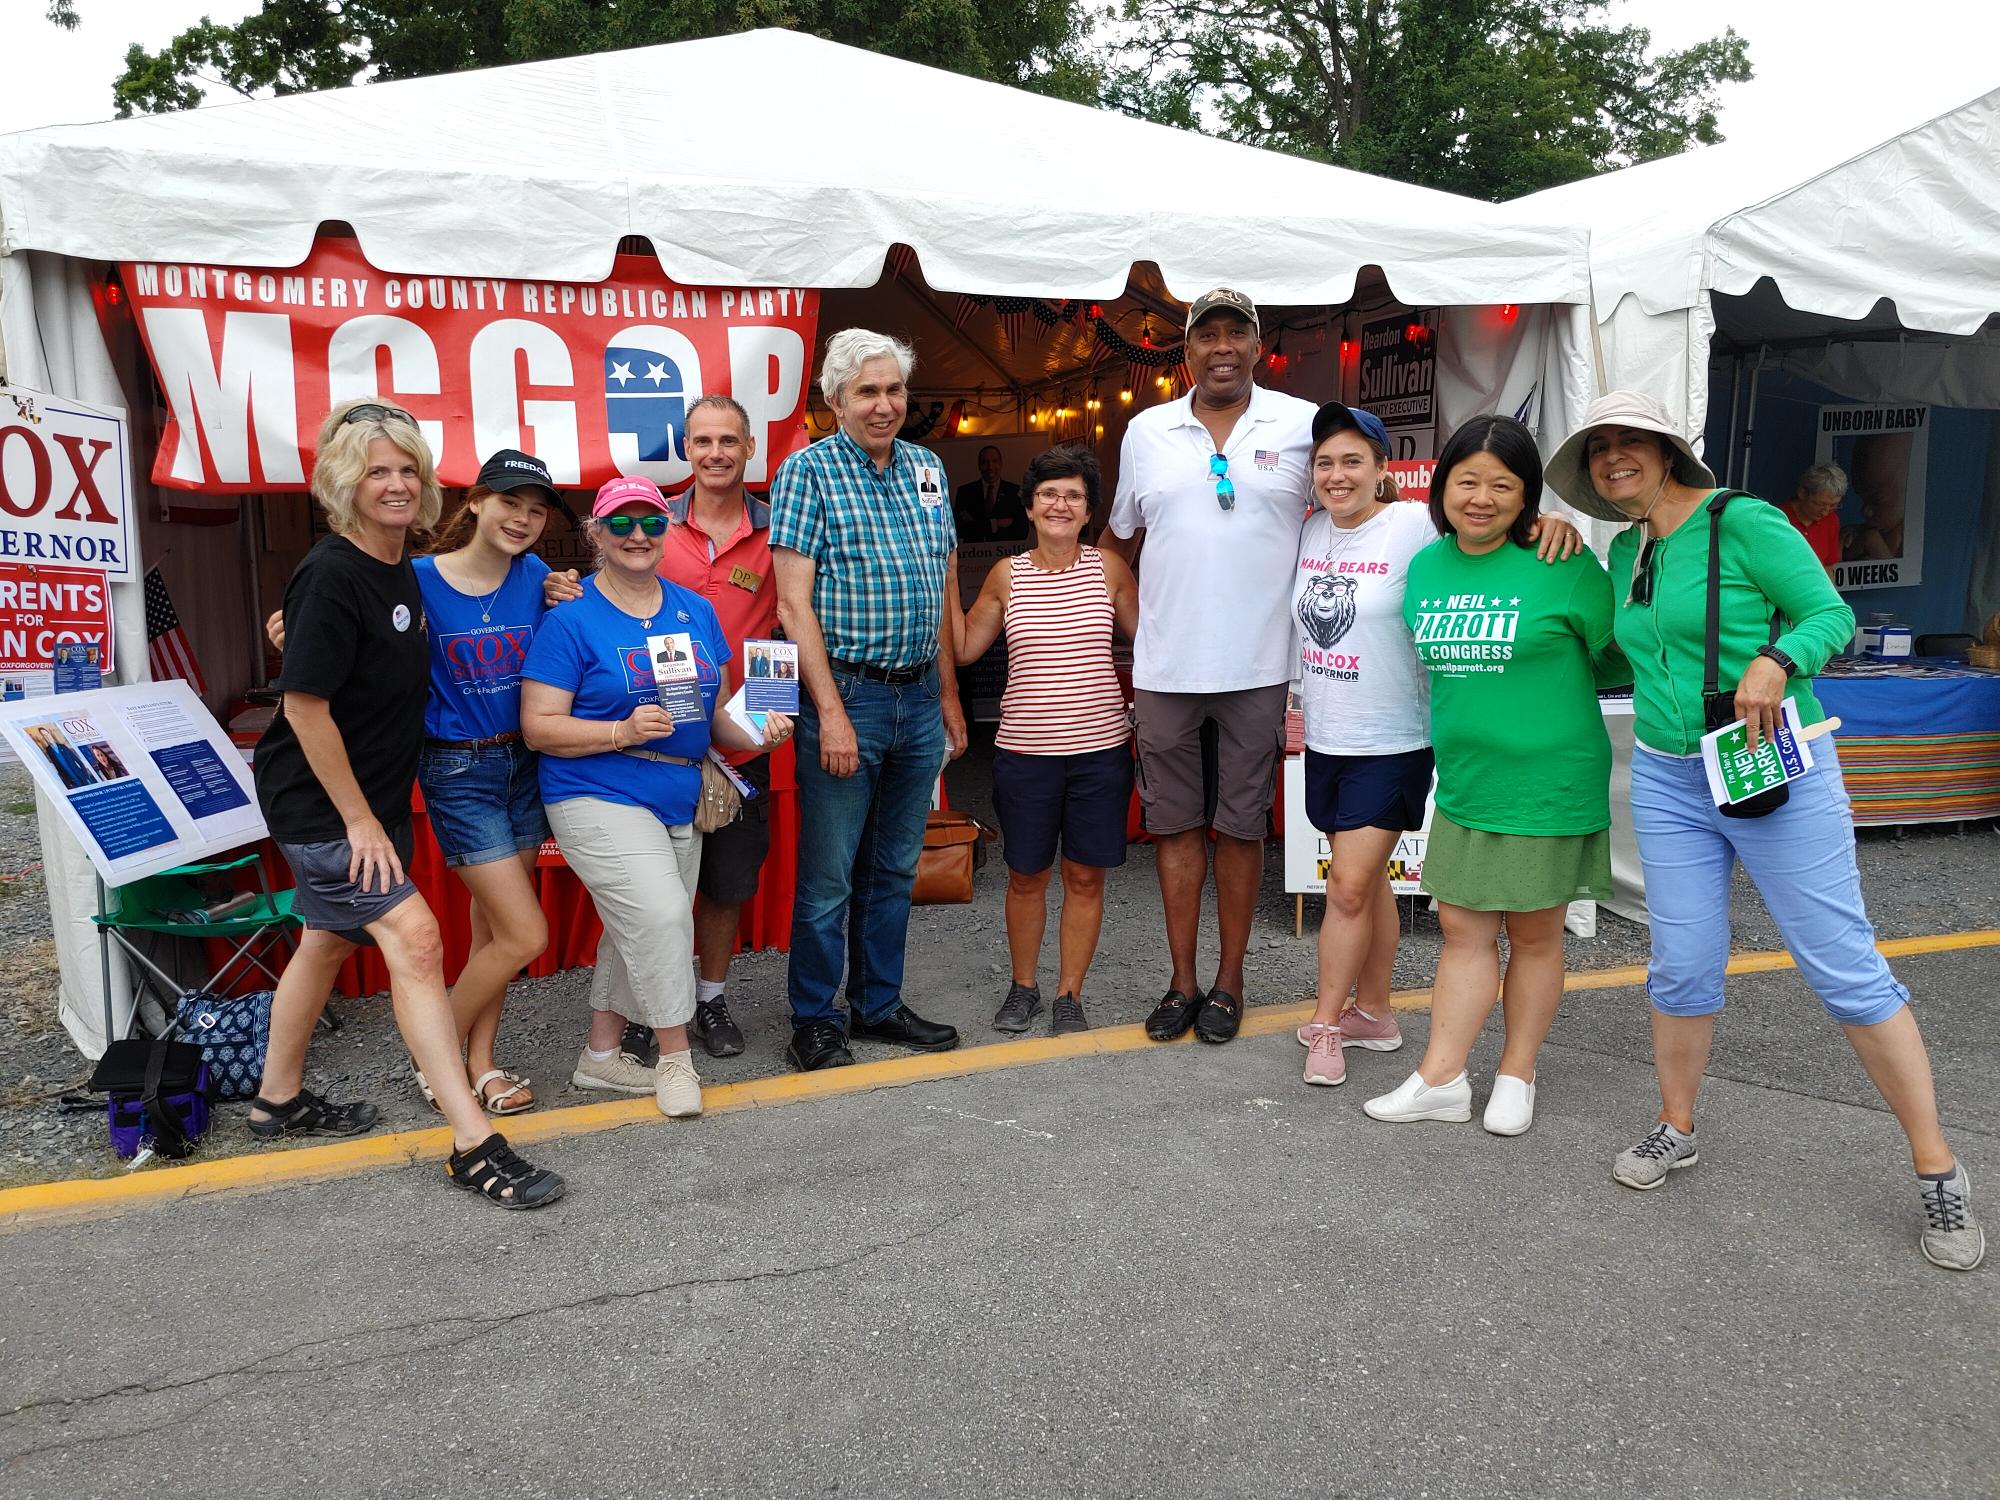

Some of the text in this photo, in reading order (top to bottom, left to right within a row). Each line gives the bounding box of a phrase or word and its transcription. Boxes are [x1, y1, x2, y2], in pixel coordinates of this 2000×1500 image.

[135, 264, 806, 318] MONTGOMERY COUNTY REPUBLICAN PARTY
[1364, 326, 1400, 351] Reardon
[1361, 356, 1433, 400] Sullivan
[142, 307, 805, 485] MCGOP
[1389, 398, 1428, 415] EXECUTIVE
[1823, 407, 1927, 432] UNBORN BABY
[0, 425, 118, 525] OX
[1257, 464, 1274, 473] USA
[1, 530, 120, 564] ERNOR
[733, 568, 751, 582] DP
[1338, 561, 1390, 575] BEARS
[1834, 563, 1899, 588] 0 WEEKS
[0, 581, 103, 613] RENTS
[1446, 594, 1486, 610] NEIL
[16, 613, 44, 626] FOR
[470, 625, 506, 635] GOVERNOR
[1415, 613, 1516, 640] PARROTT
[447, 631, 527, 668] COX
[773, 648, 793, 656] COX
[1430, 644, 1513, 660] CONGRESS
[658, 667, 692, 675] Sullivan
[1327, 653, 1360, 670] COX
[1312, 665, 1359, 680] GOVERNOR
[62, 718, 96, 735] COX
[1734, 743, 1757, 778] NEIL
[1778, 727, 1801, 775] U.S. Cong
